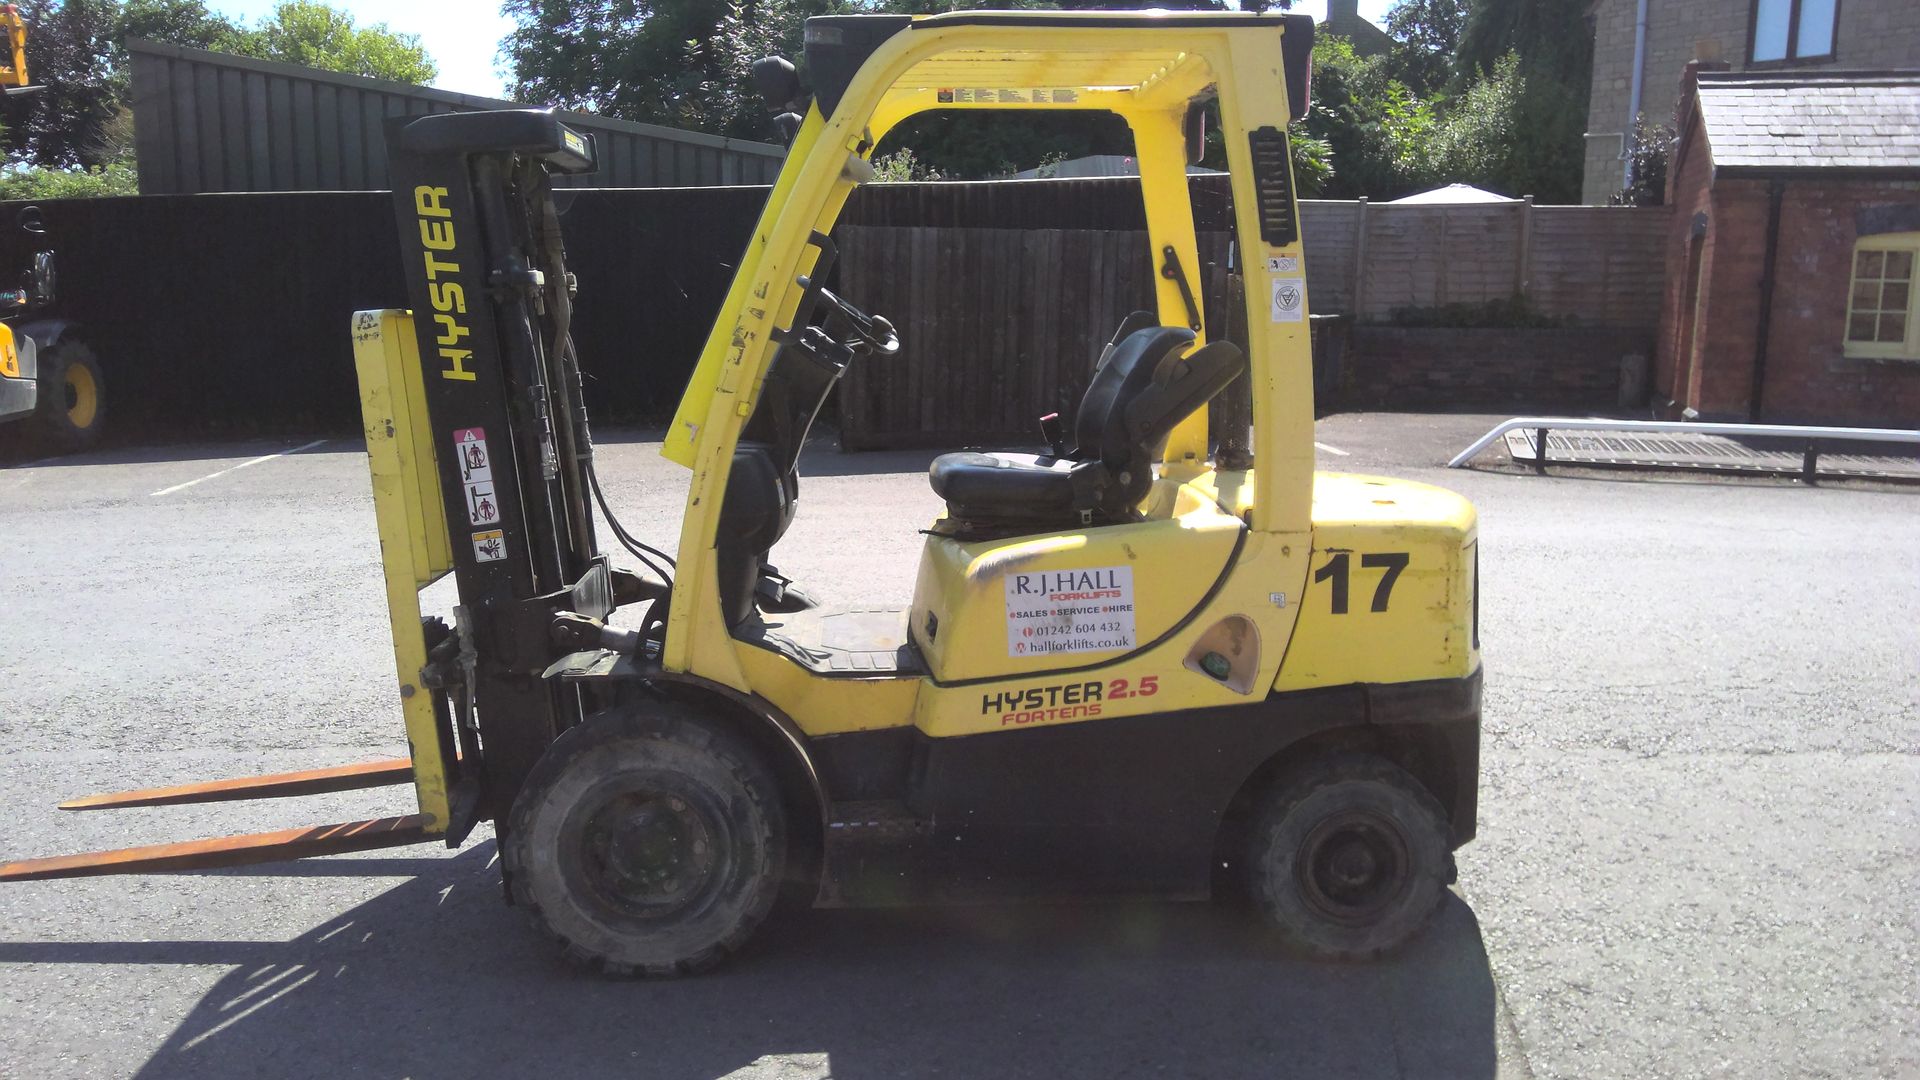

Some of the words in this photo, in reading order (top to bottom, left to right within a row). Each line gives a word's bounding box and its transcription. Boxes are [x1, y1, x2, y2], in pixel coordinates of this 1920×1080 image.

[414, 185, 477, 381] HYSTER
[1314, 552, 1410, 615] 17
[1050, 589, 1122, 602] FORKLIFTS
[1016, 610, 1048, 619] SALES
[1056, 606, 1100, 617] SERVICE
[1108, 604, 1133, 613] HIRE
[1036, 625, 1072, 636] 01242
[1075, 624, 1096, 634] 604
[1100, 622, 1121, 632] 432
[1030, 637, 1129, 652] hallforklifts.co.uk
[982, 681, 1103, 714] HYSTER
[1107, 675, 1159, 700] 2.5
[1002, 704, 1102, 726] FORTENS
